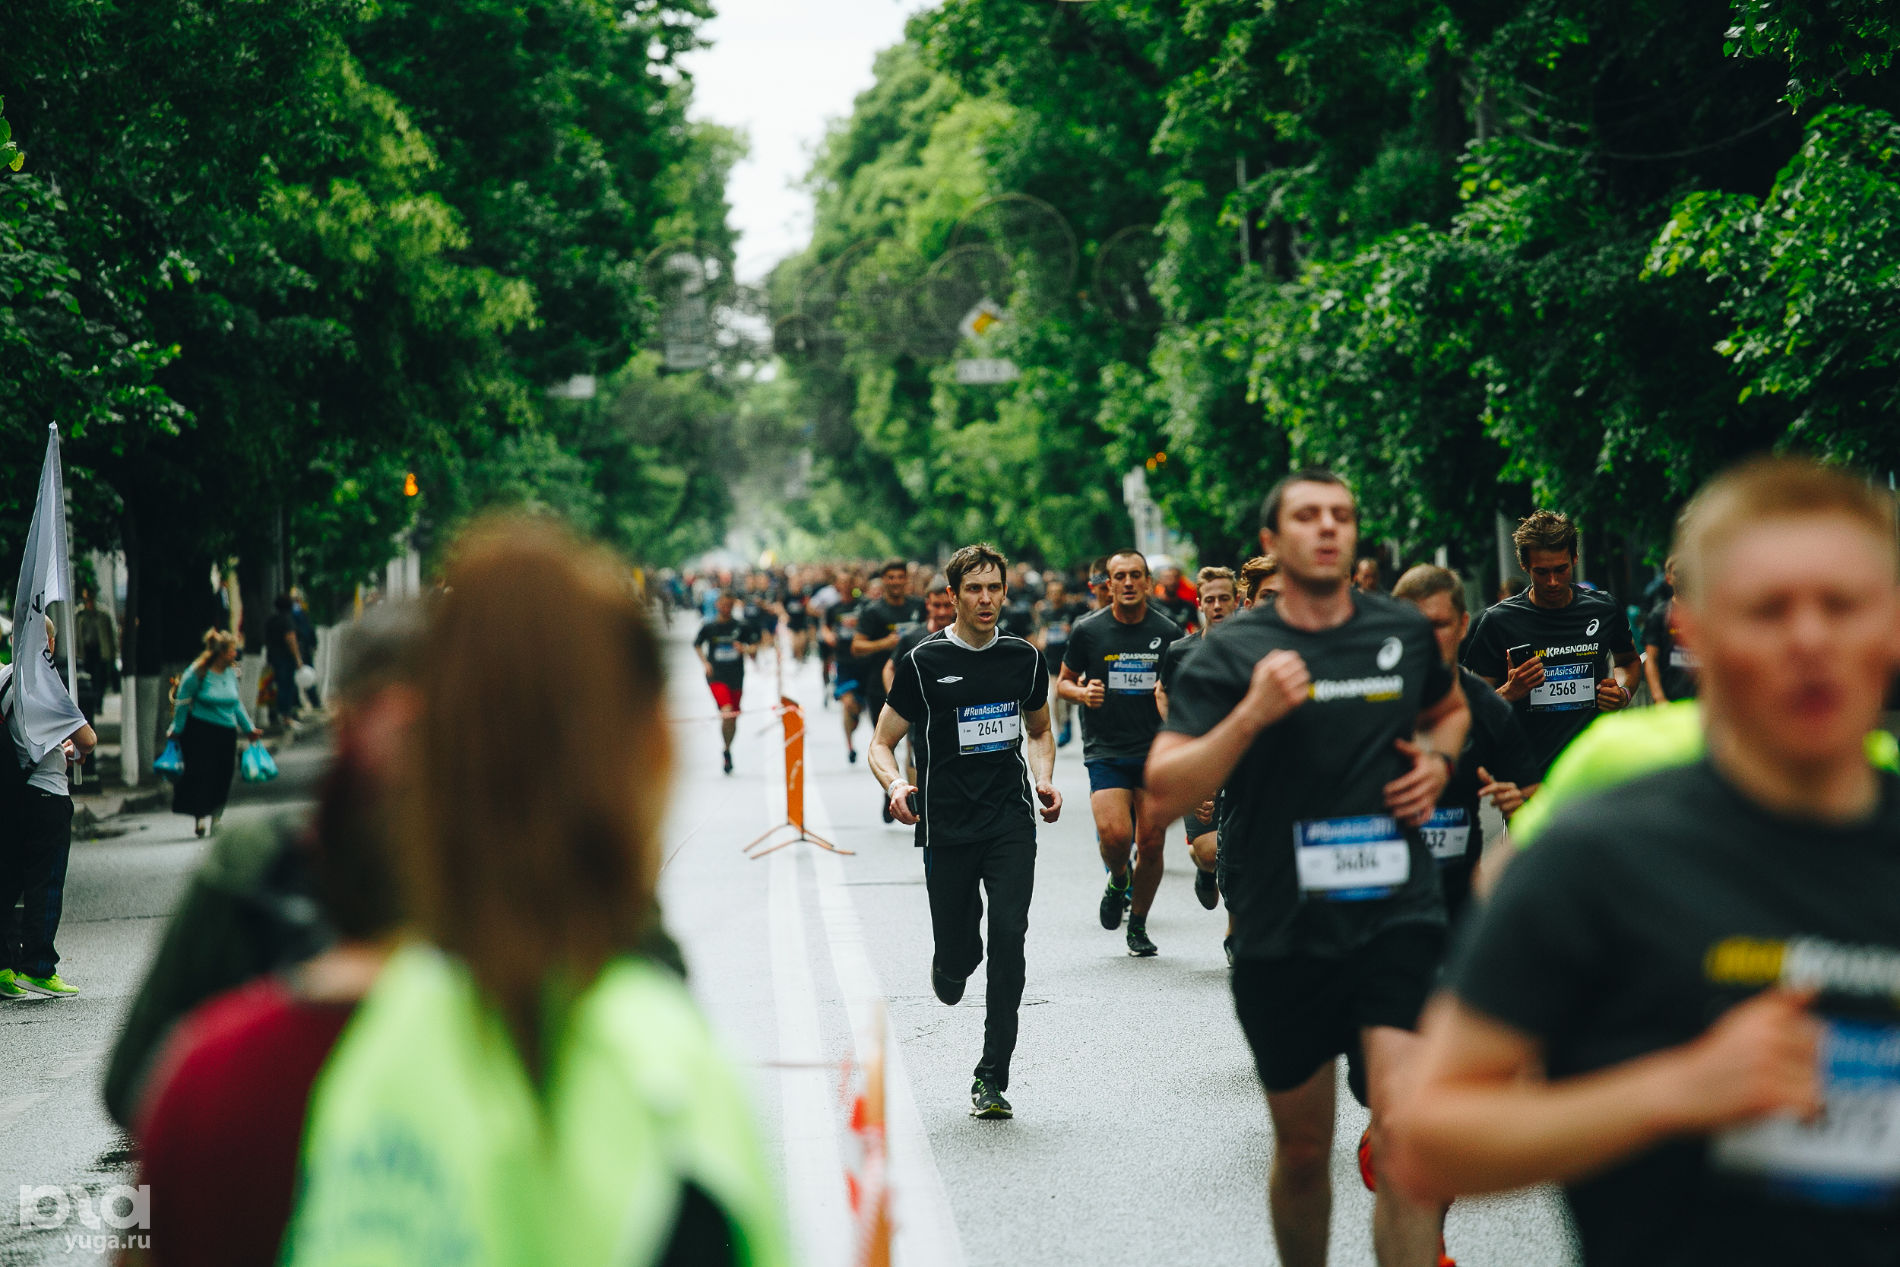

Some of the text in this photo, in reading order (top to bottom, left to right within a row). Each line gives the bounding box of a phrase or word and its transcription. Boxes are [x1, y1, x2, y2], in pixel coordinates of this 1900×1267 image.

[1123, 674, 1143, 683] 1464
[1549, 682, 1576, 696] 2568
[963, 702, 1015, 717] #RunAsics2017
[978, 721, 1004, 736] 2641
